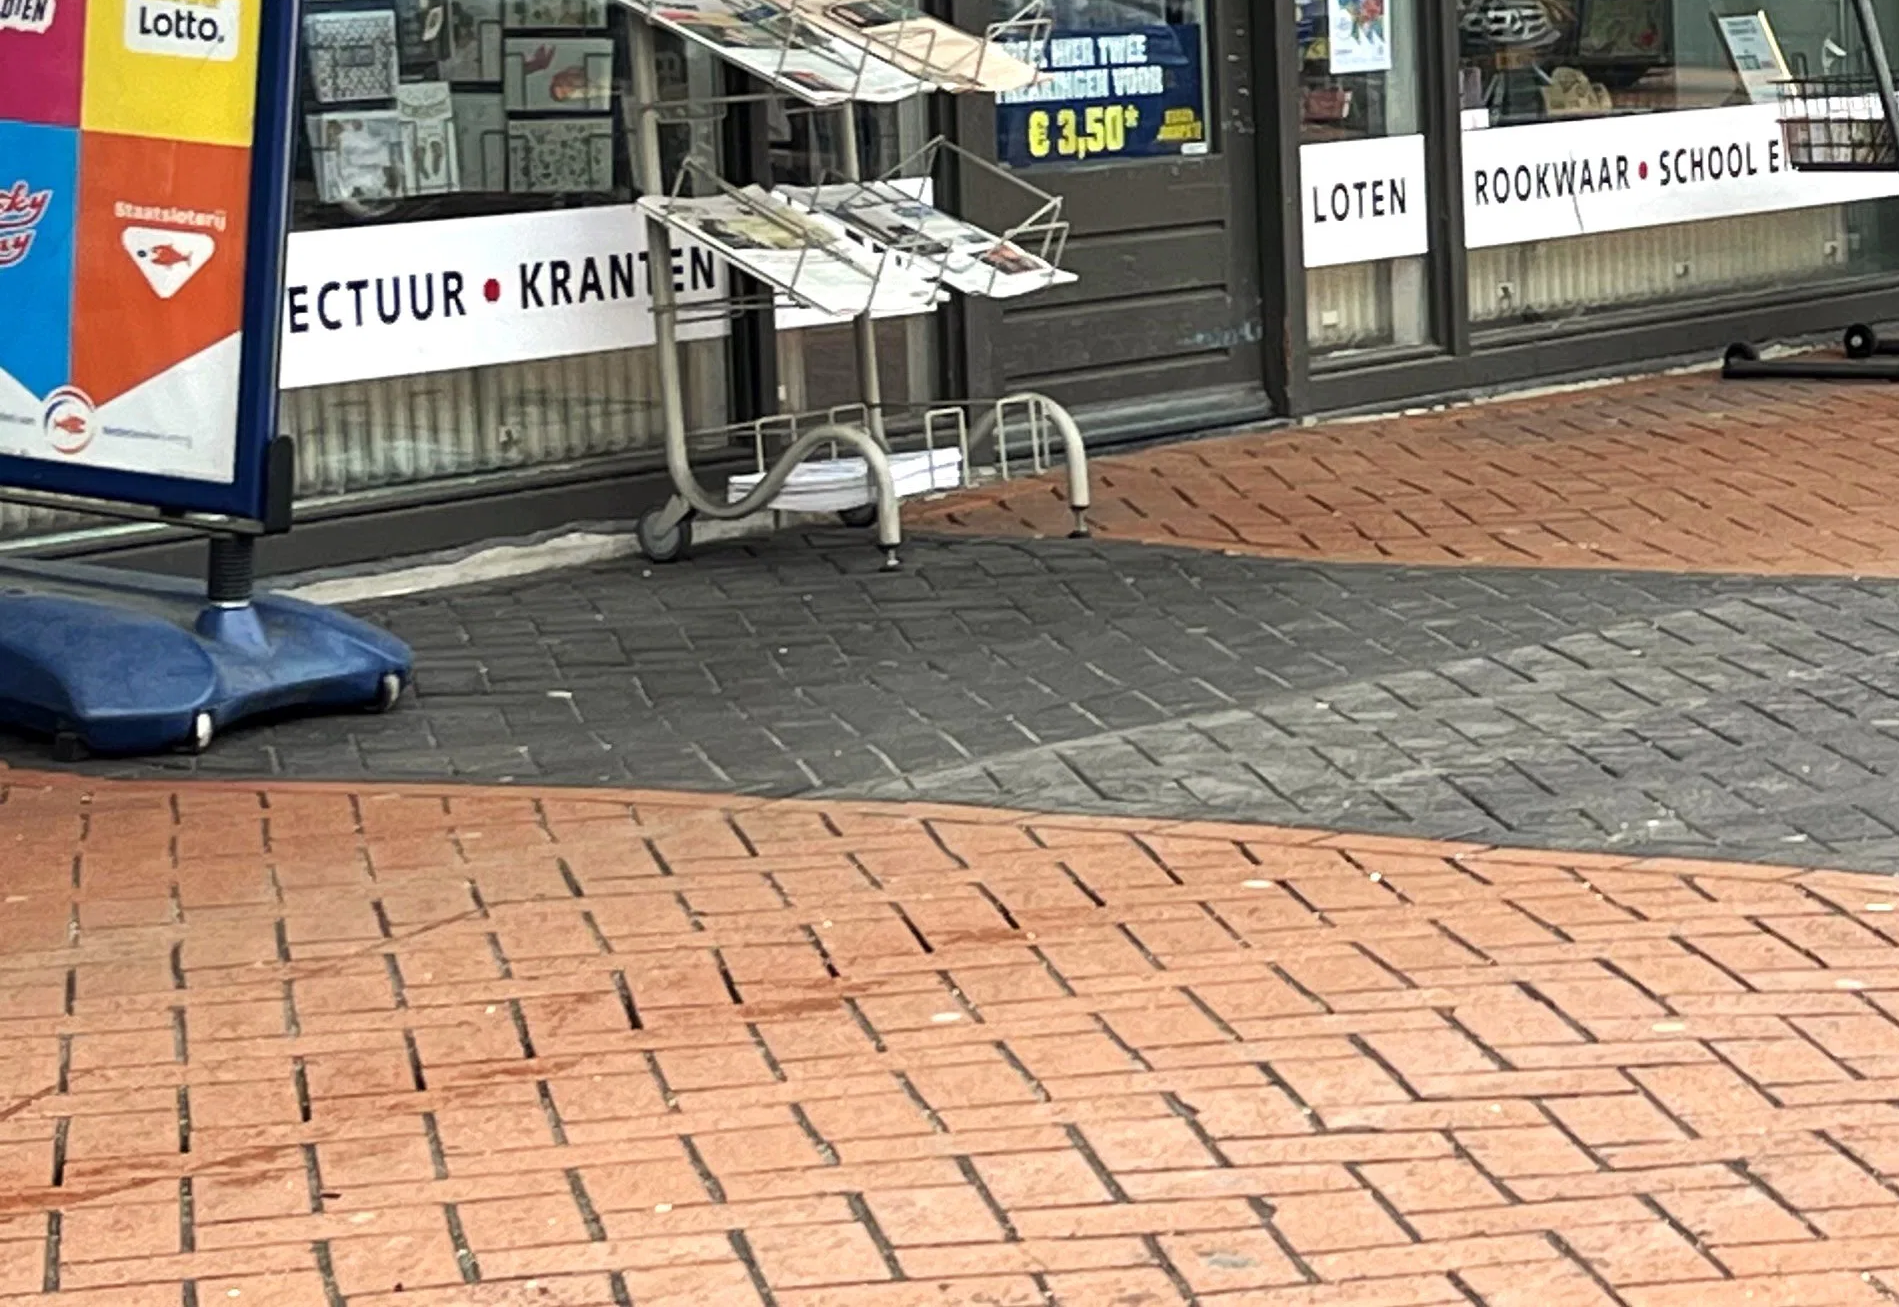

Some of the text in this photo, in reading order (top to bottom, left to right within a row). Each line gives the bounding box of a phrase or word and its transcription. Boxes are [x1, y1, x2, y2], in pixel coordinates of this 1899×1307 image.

[139, 5, 225, 44] Lotto.
[1028, 109, 1050, 158] €
[1475, 154, 1632, 207] ROOKWAAR
[1658, 139, 1758, 188] SCHOOL
[114, 200, 228, 233] Staatsloterij
[1312, 176, 1408, 225] LOTEN
[287, 270, 467, 334] ECTUUR
